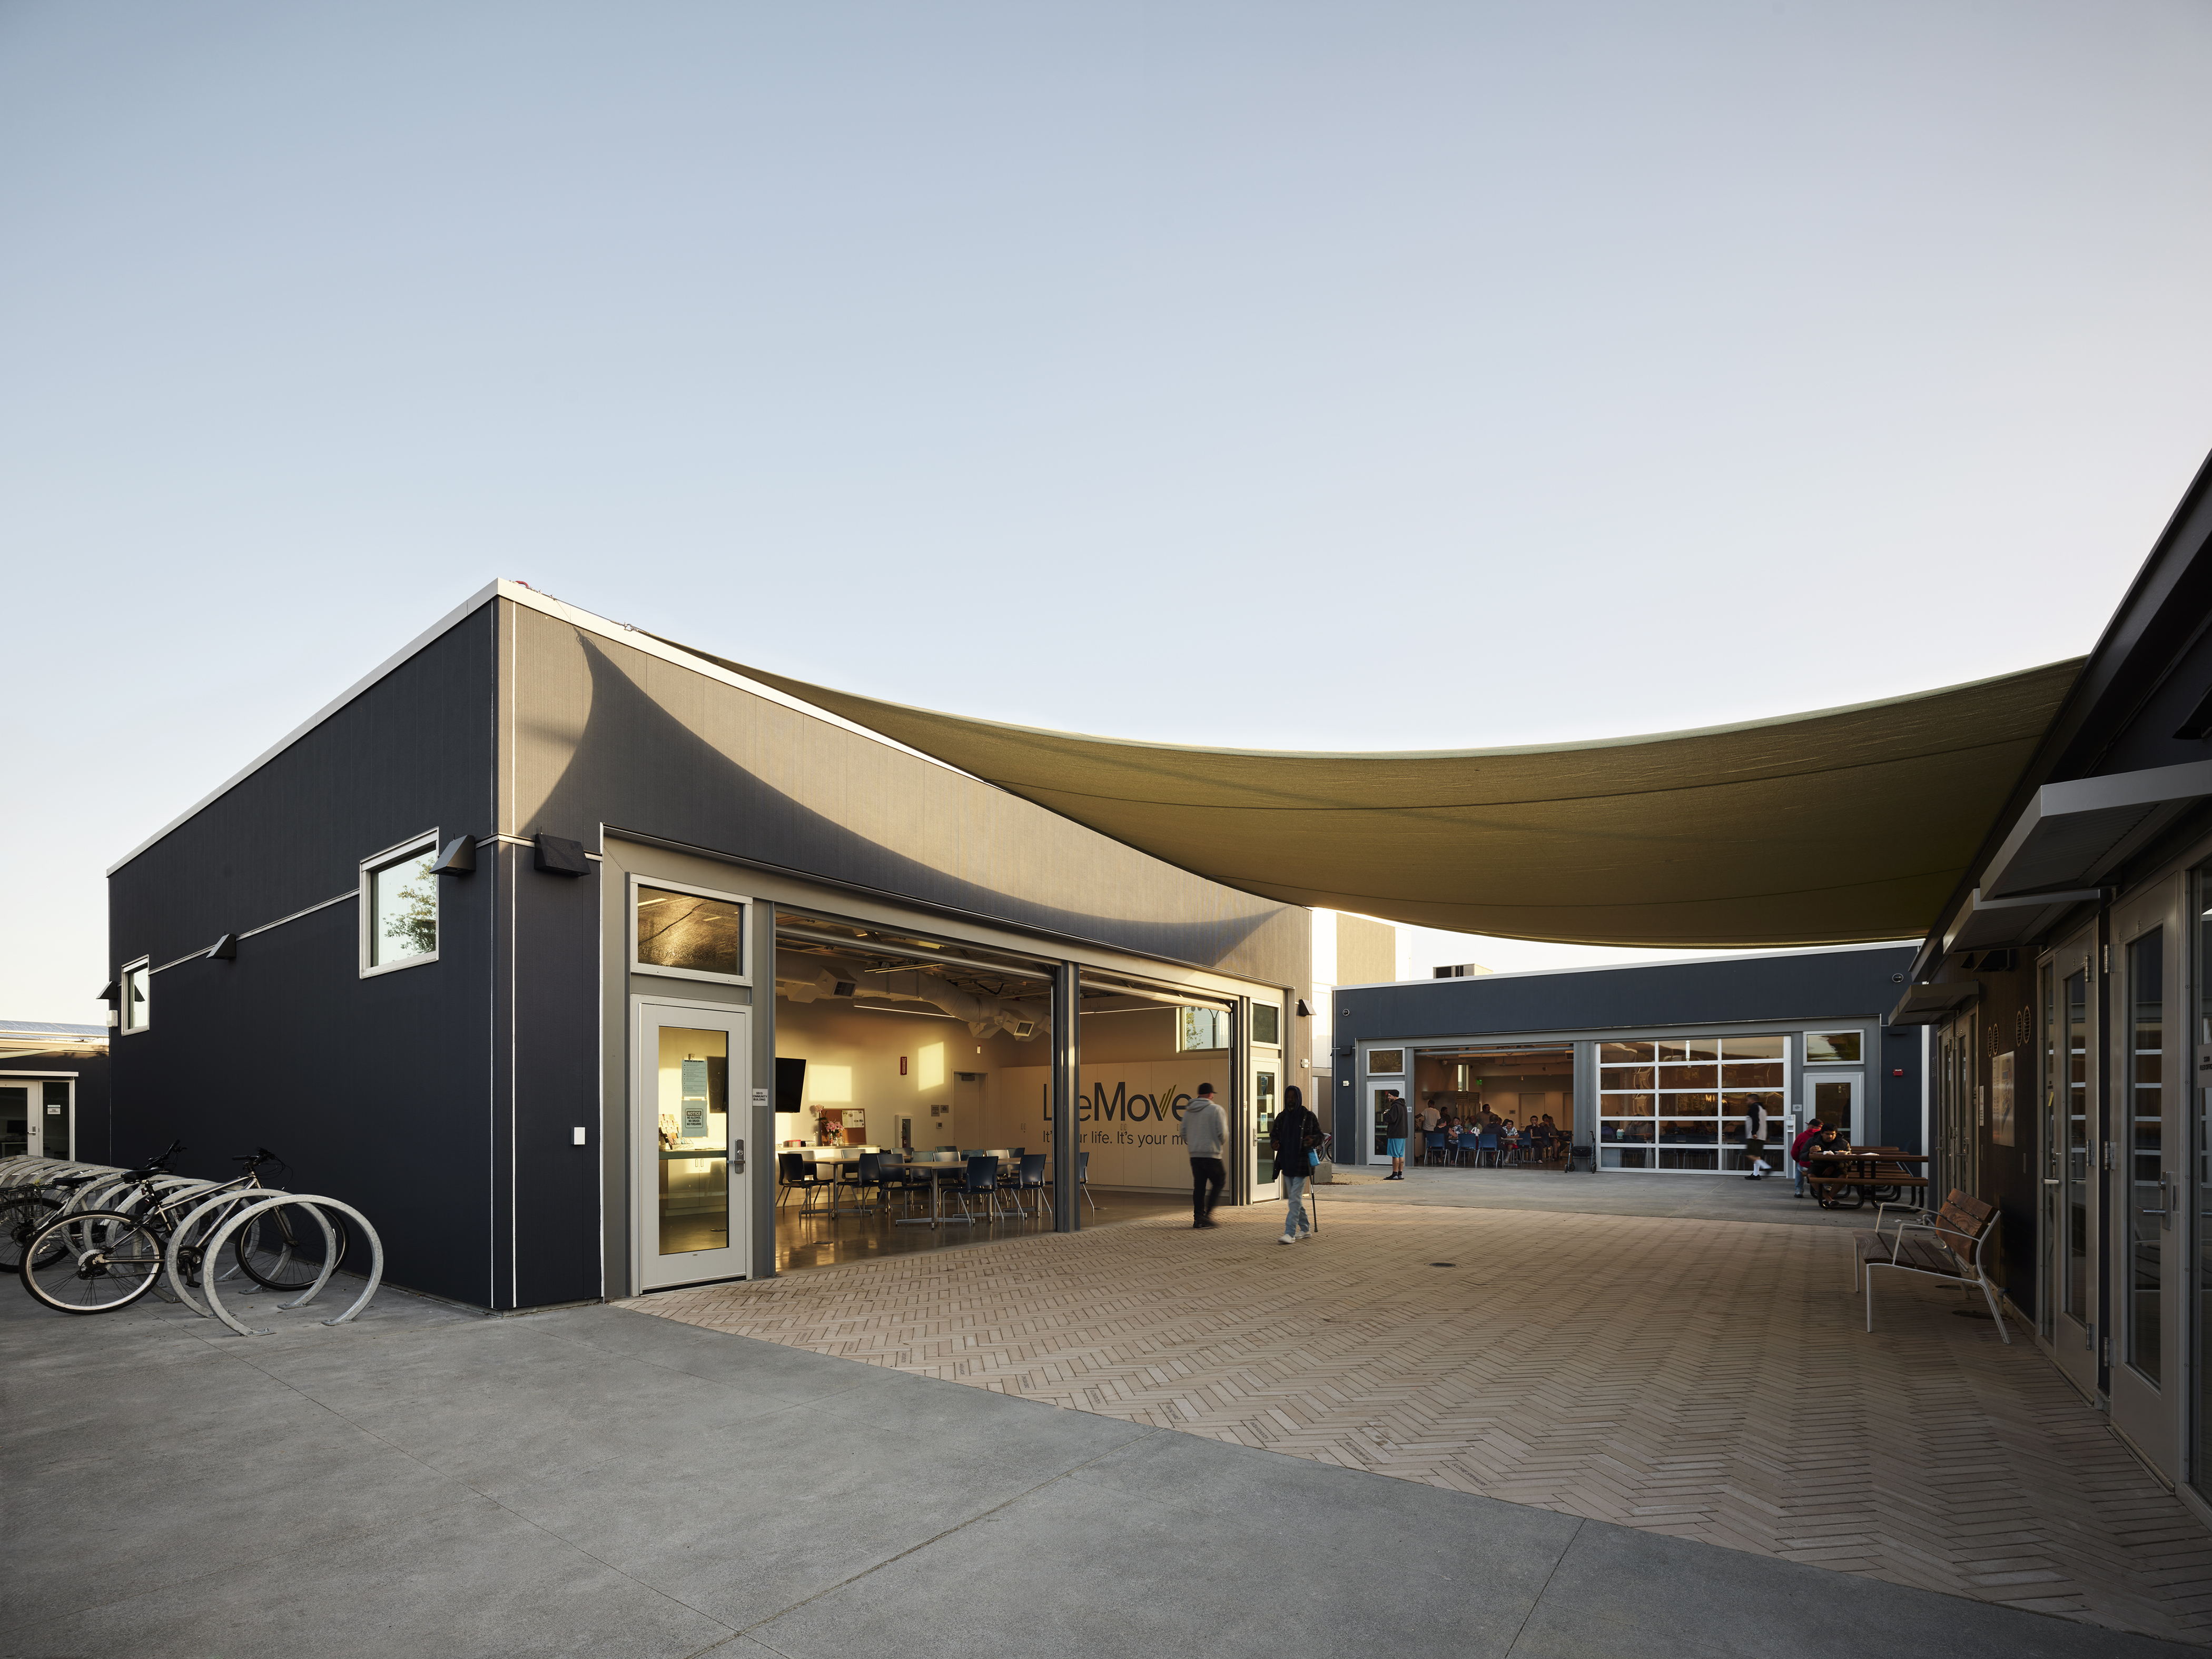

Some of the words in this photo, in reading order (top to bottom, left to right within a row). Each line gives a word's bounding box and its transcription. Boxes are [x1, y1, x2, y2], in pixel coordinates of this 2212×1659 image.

[1043, 1082, 1199, 1121] LeMove
[1043, 1131, 1052, 1143] It'
[1092, 1131, 1112, 1144] life.
[1118, 1131, 1133, 1144] It's
[1138, 1134, 1168, 1148] your
